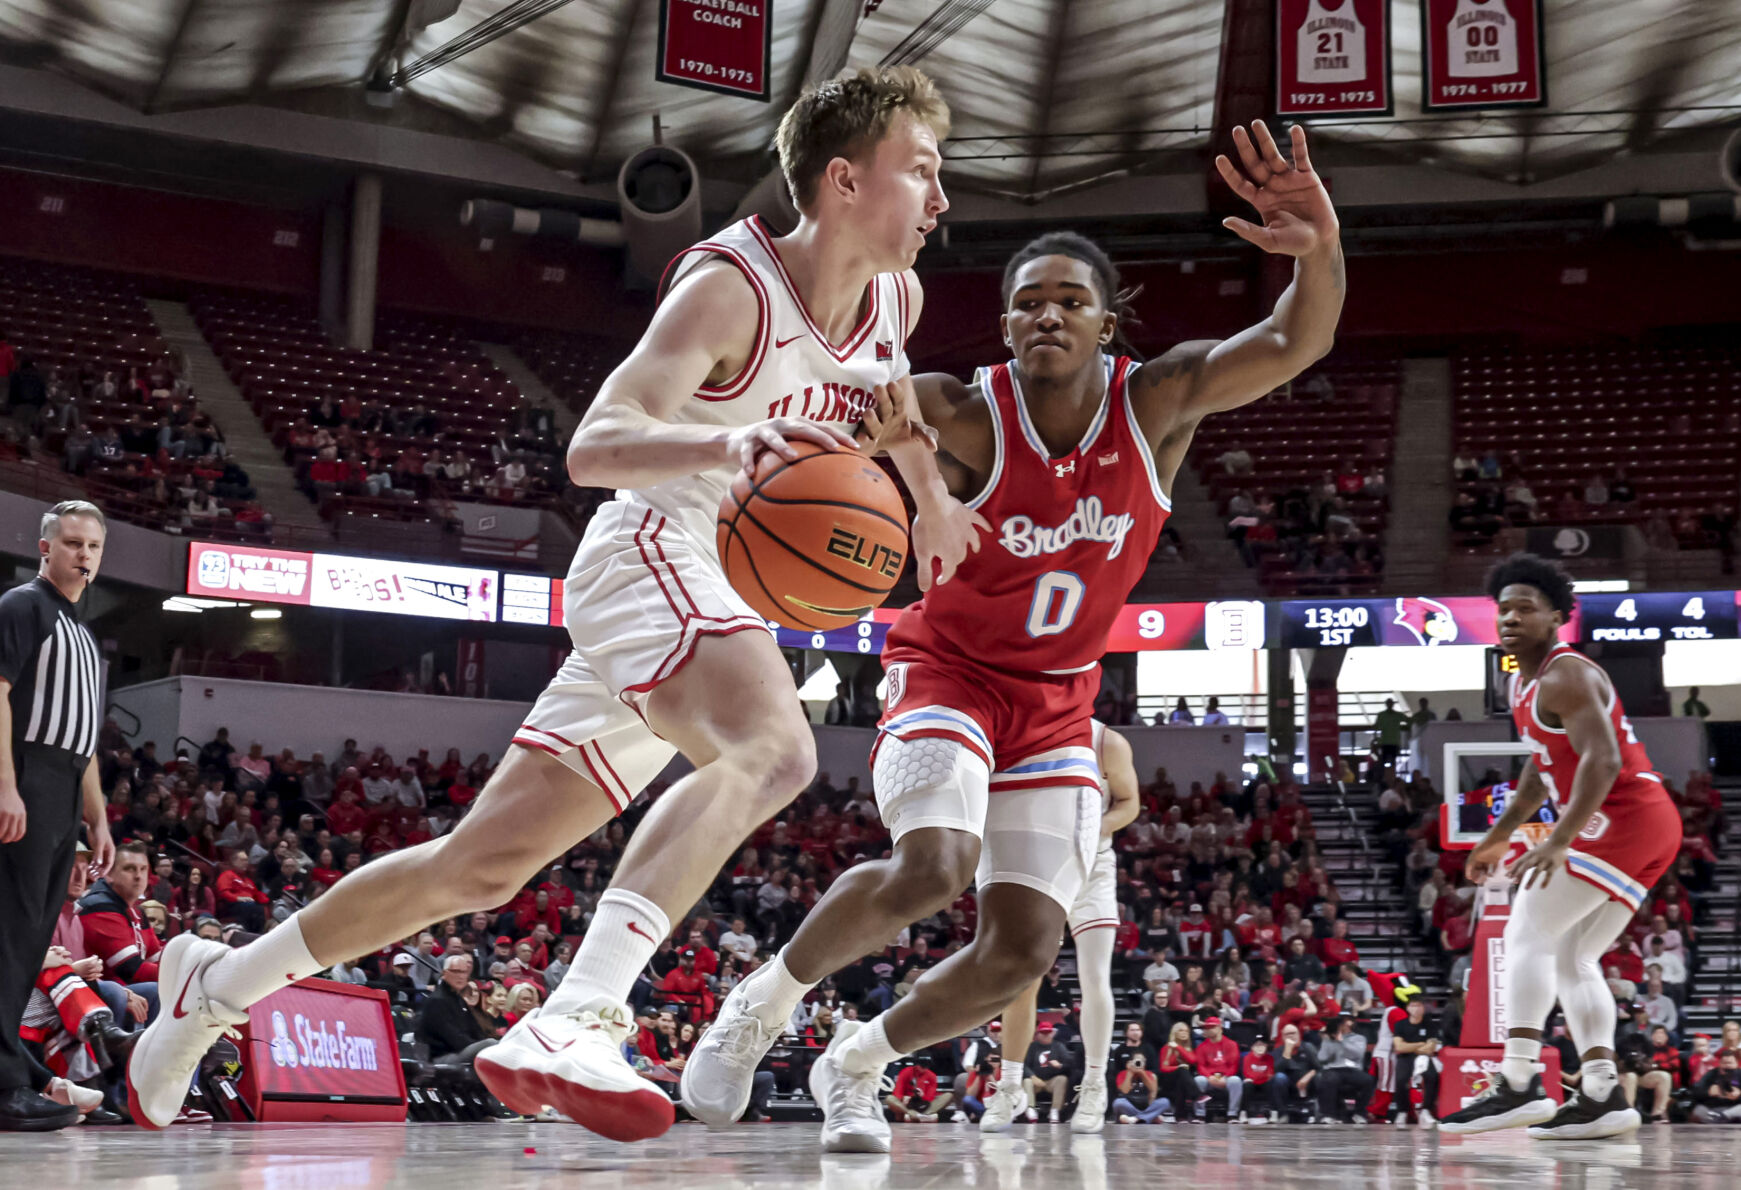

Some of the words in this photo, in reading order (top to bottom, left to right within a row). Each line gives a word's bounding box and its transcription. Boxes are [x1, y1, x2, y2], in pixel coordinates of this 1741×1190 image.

[693, 9, 741, 29] COACH
[1317, 32, 1343, 54] 21
[1467, 25, 1498, 47] 00
[1314, 56, 1349, 70] STATE
[1465, 49, 1501, 64] STATE
[1290, 93, 1325, 104] 1972
[1340, 90, 1375, 103] 1975
[1442, 84, 1477, 97] 1974
[1492, 81, 1528, 94] 1977
[998, 496, 1134, 560] Bradley
[231, 553, 268, 570] TRY
[270, 558, 307, 574] THE
[826, 528, 903, 579] ELITE
[229, 567, 306, 596] NEW
[1026, 570, 1086, 638] 0
[1614, 598, 1638, 621] 4
[1682, 597, 1706, 620] 4
[1138, 610, 1165, 638] 9
[1305, 607, 1369, 628] 13:00
[858, 622, 872, 637] 0
[1320, 628, 1354, 645] 1ST
[1592, 627, 1661, 641] FOULS
[1670, 626, 1714, 639] TOL
[811, 634, 825, 649] 0
[857, 638, 871, 653] 0
